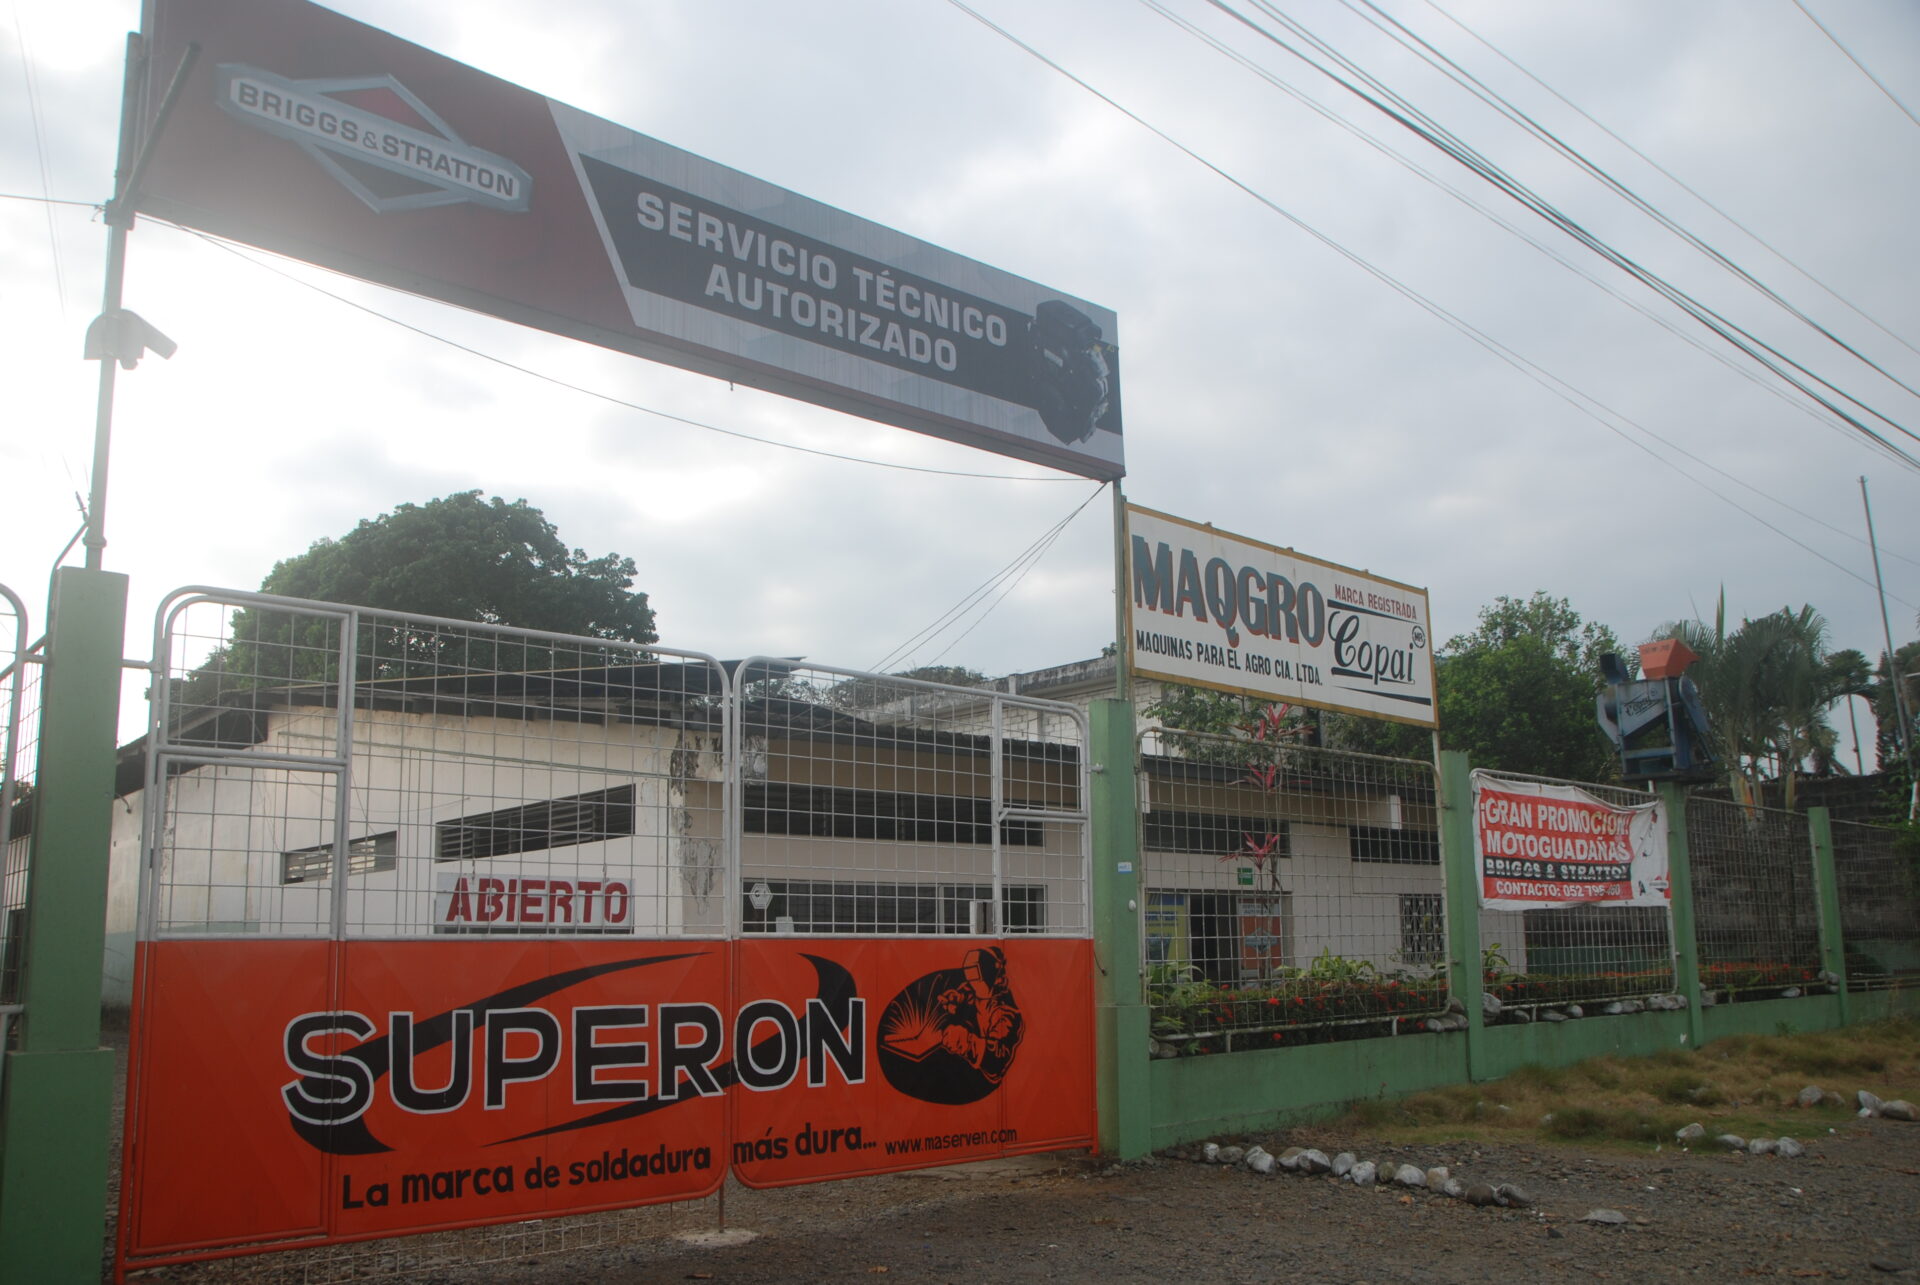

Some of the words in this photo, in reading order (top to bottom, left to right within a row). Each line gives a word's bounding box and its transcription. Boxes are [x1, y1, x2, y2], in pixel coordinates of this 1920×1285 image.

[636, 191, 837, 290] SERVICIO
[852, 267, 1007, 347] TÉCNICO
[705, 264, 958, 372] AUTORIZADO
[1132, 534, 1325, 648] MAQGRO
[1335, 584, 1364, 607] MARCA
[1368, 593, 1417, 620] REGISTRADA
[1136, 629, 1193, 660] MAQUINAS
[1197, 642, 1225, 667] PARA
[1228, 649, 1241, 670] EL
[1245, 653, 1271, 676] AGRO
[1275, 659, 1293, 680] CIA.
[1296, 663, 1323, 686] LTDA.
[1328, 611, 1414, 685] Copai
[1480, 797, 1532, 829] ¡GRAN
[1485, 858, 1541, 878] BRIGGS
[1547, 865, 1556, 879] &
[1486, 829, 1631, 862] MOTOGUADAÑAS
[446, 877, 628, 923] ABIERTO
[1496, 881, 1560, 897] CONTACTO:
[282, 998, 866, 1125] SUPERON
[885, 1126, 1018, 1156] www.maserven.com
[342, 1173, 388, 1210] La
[402, 1162, 514, 1205] marca
[525, 1156, 560, 1190] de
[569, 1143, 711, 1186] soldadura
[733, 1127, 788, 1166] más
